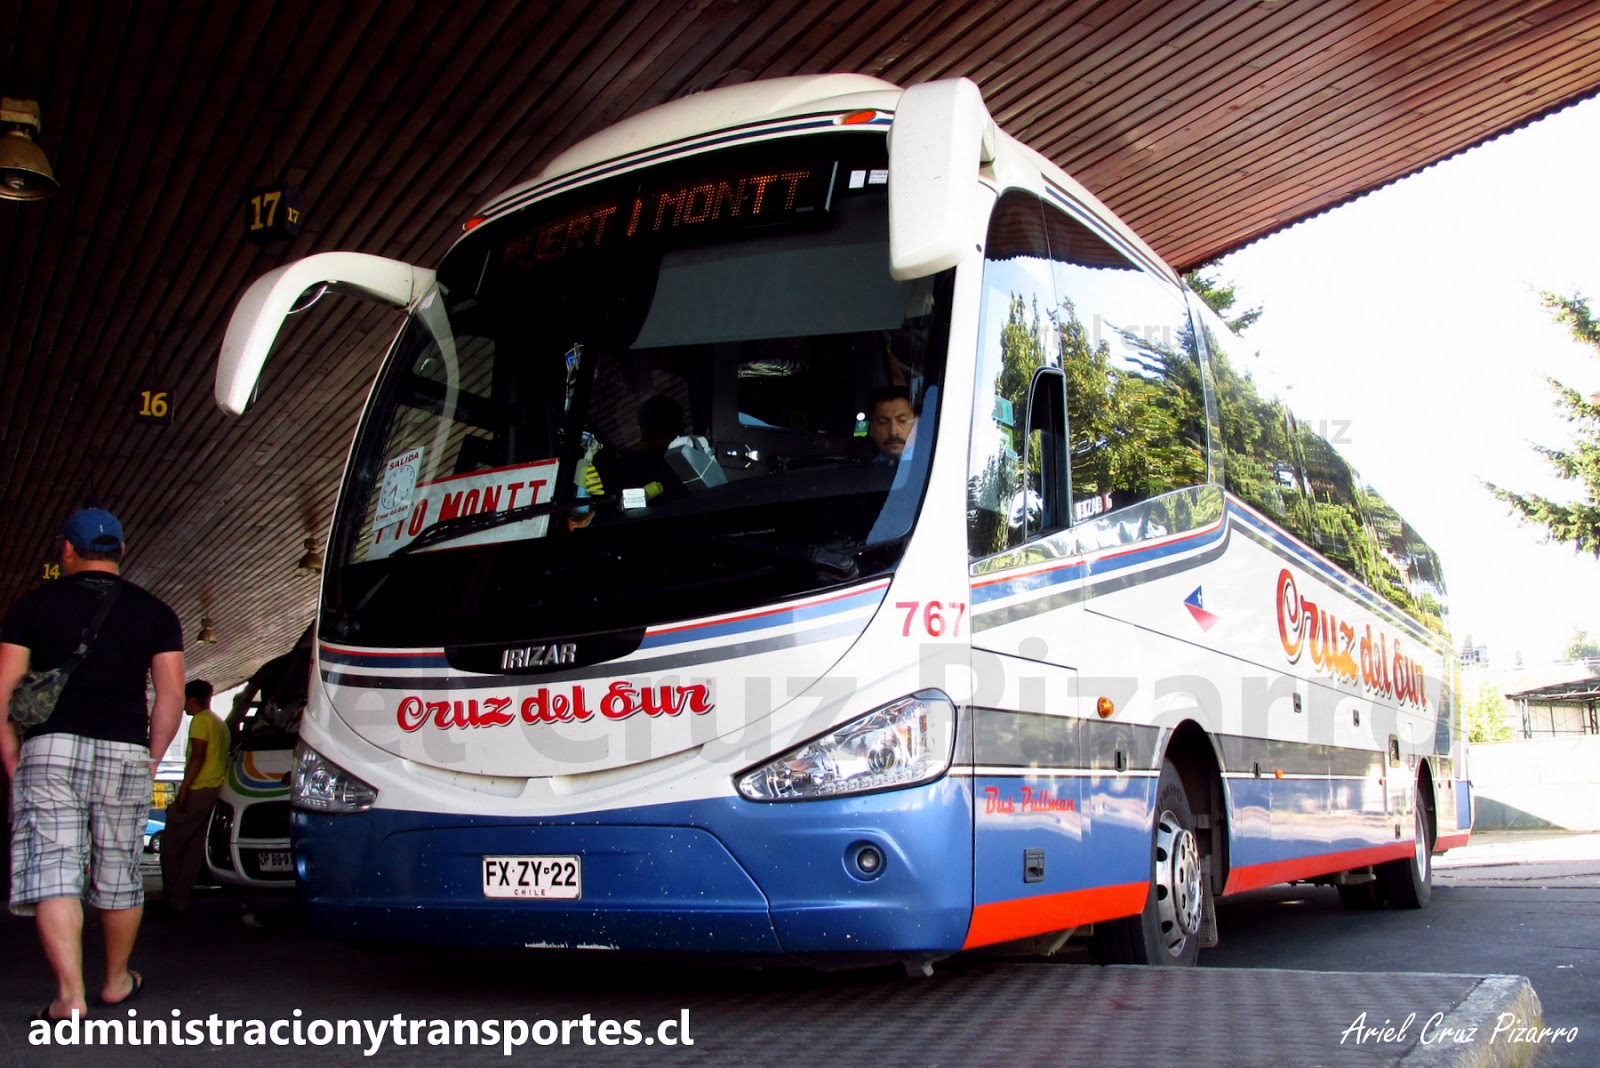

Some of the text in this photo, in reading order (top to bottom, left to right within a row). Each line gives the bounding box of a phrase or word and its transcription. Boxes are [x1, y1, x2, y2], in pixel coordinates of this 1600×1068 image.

[250, 190, 281, 231] 17
[287, 206, 299, 224] 17
[652, 171, 810, 231] MONTT
[139, 390, 168, 417] 16
[389, 452, 420, 471] SALIDA
[438, 479, 547, 523] MONTT
[42, 563, 60, 580] 14
[895, 600, 965, 637] 767
[1276, 568, 1358, 685] Cruz
[1360, 623, 1392, 698] del
[501, 643, 577, 670] IRIZAR
[397, 680, 715, 733] Cruz del Sur
[984, 786, 1075, 814] Bus Pullman
[514, 888, 546, 896] CHILE
